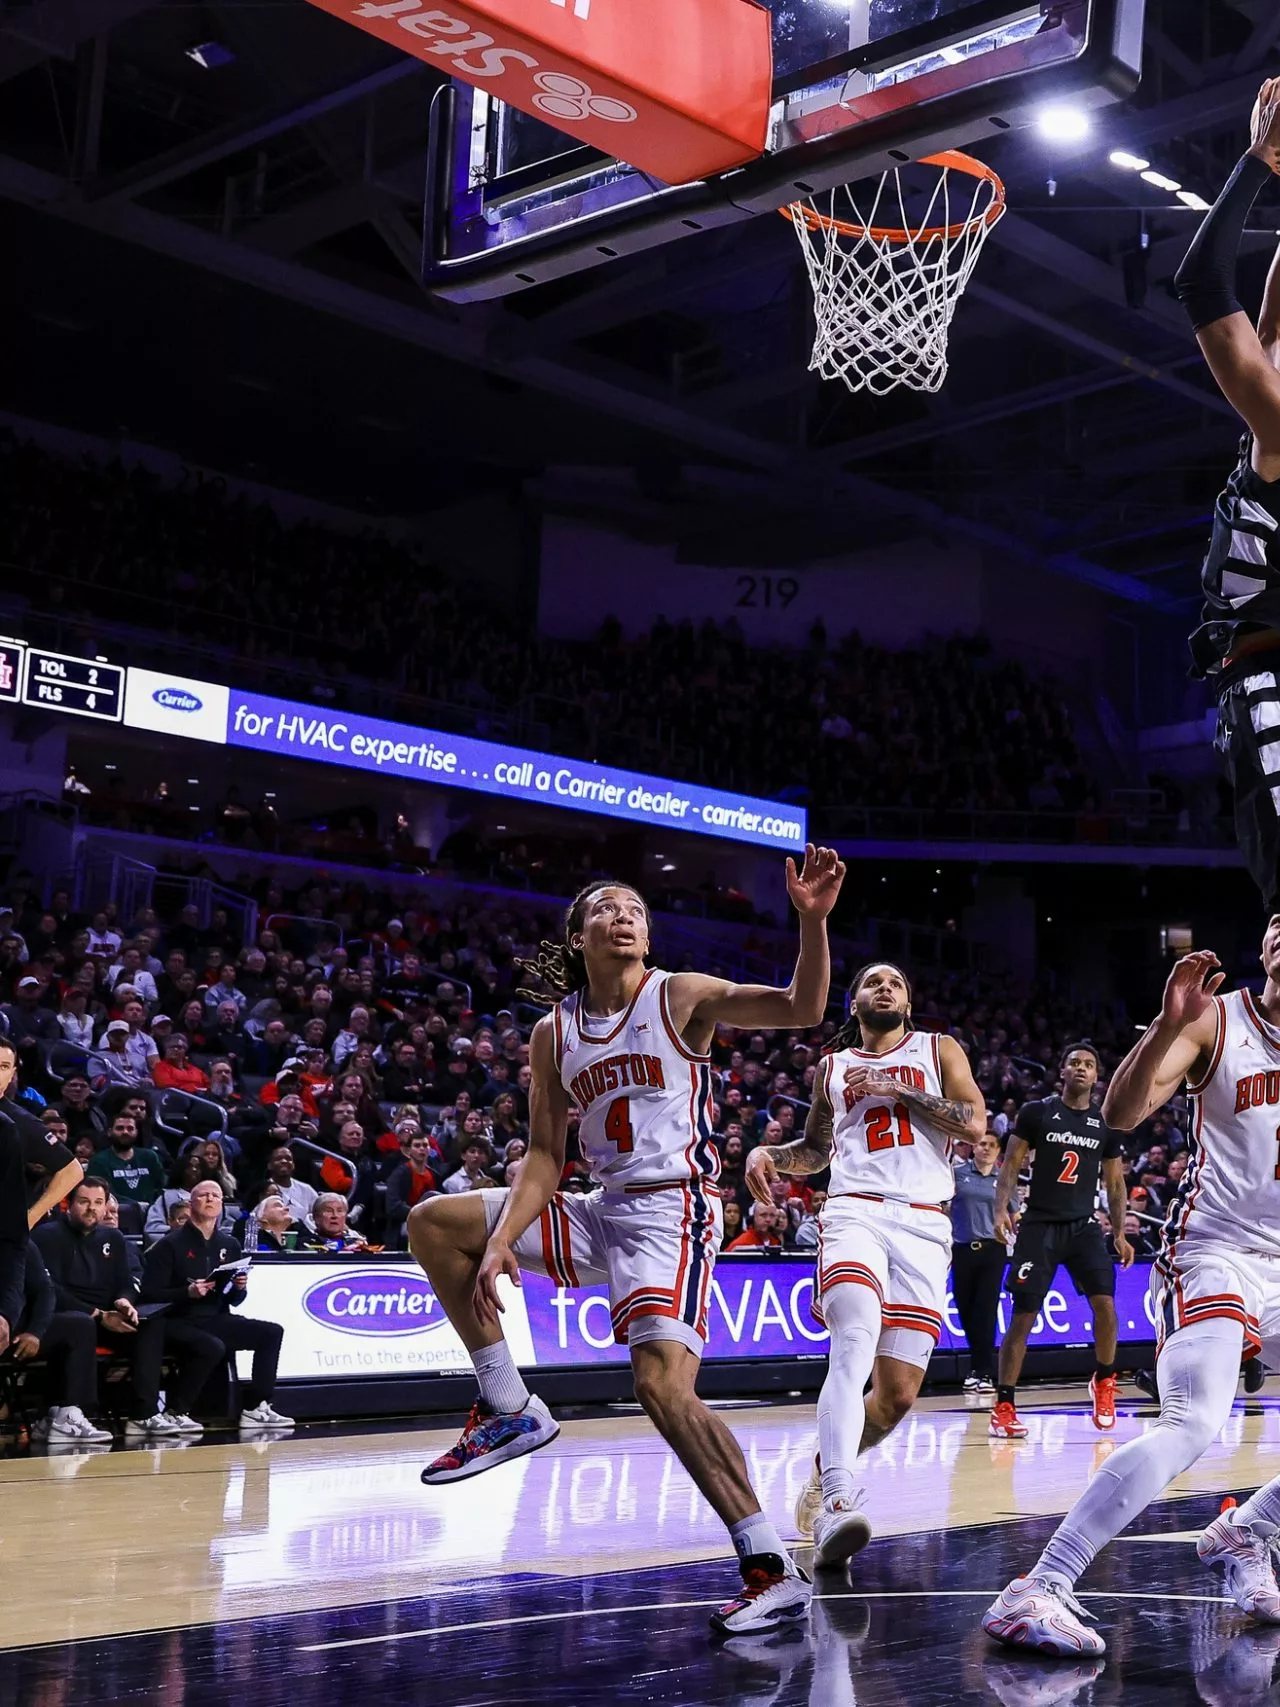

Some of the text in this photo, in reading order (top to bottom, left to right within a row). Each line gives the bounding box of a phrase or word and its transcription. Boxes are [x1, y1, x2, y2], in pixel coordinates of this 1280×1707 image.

[735, 575, 799, 610] 219
[39, 659, 98, 685] TOL 2
[38, 685, 96, 709] FLS 4
[157, 690, 198, 710] Carrier
[234, 705, 274, 736] for
[276, 713, 348, 751] HVAC
[350, 734, 457, 773] expertise
[494, 762, 532, 787] call
[535, 771, 551, 791] a
[554, 769, 626, 805] Carrier
[627, 785, 691, 817] dealer
[702, 802, 801, 840] carrier.com
[569, 1053, 666, 1112] HOUSTON
[604, 1095, 635, 1154] 4
[864, 1102, 915, 1153] 21
[1045, 1131, 1100, 1150] CINCINNATI
[1057, 1150, 1080, 1184] 2
[326, 1287, 439, 1316] Carrier
[313, 1348, 467, 1367] Turn to the experts
